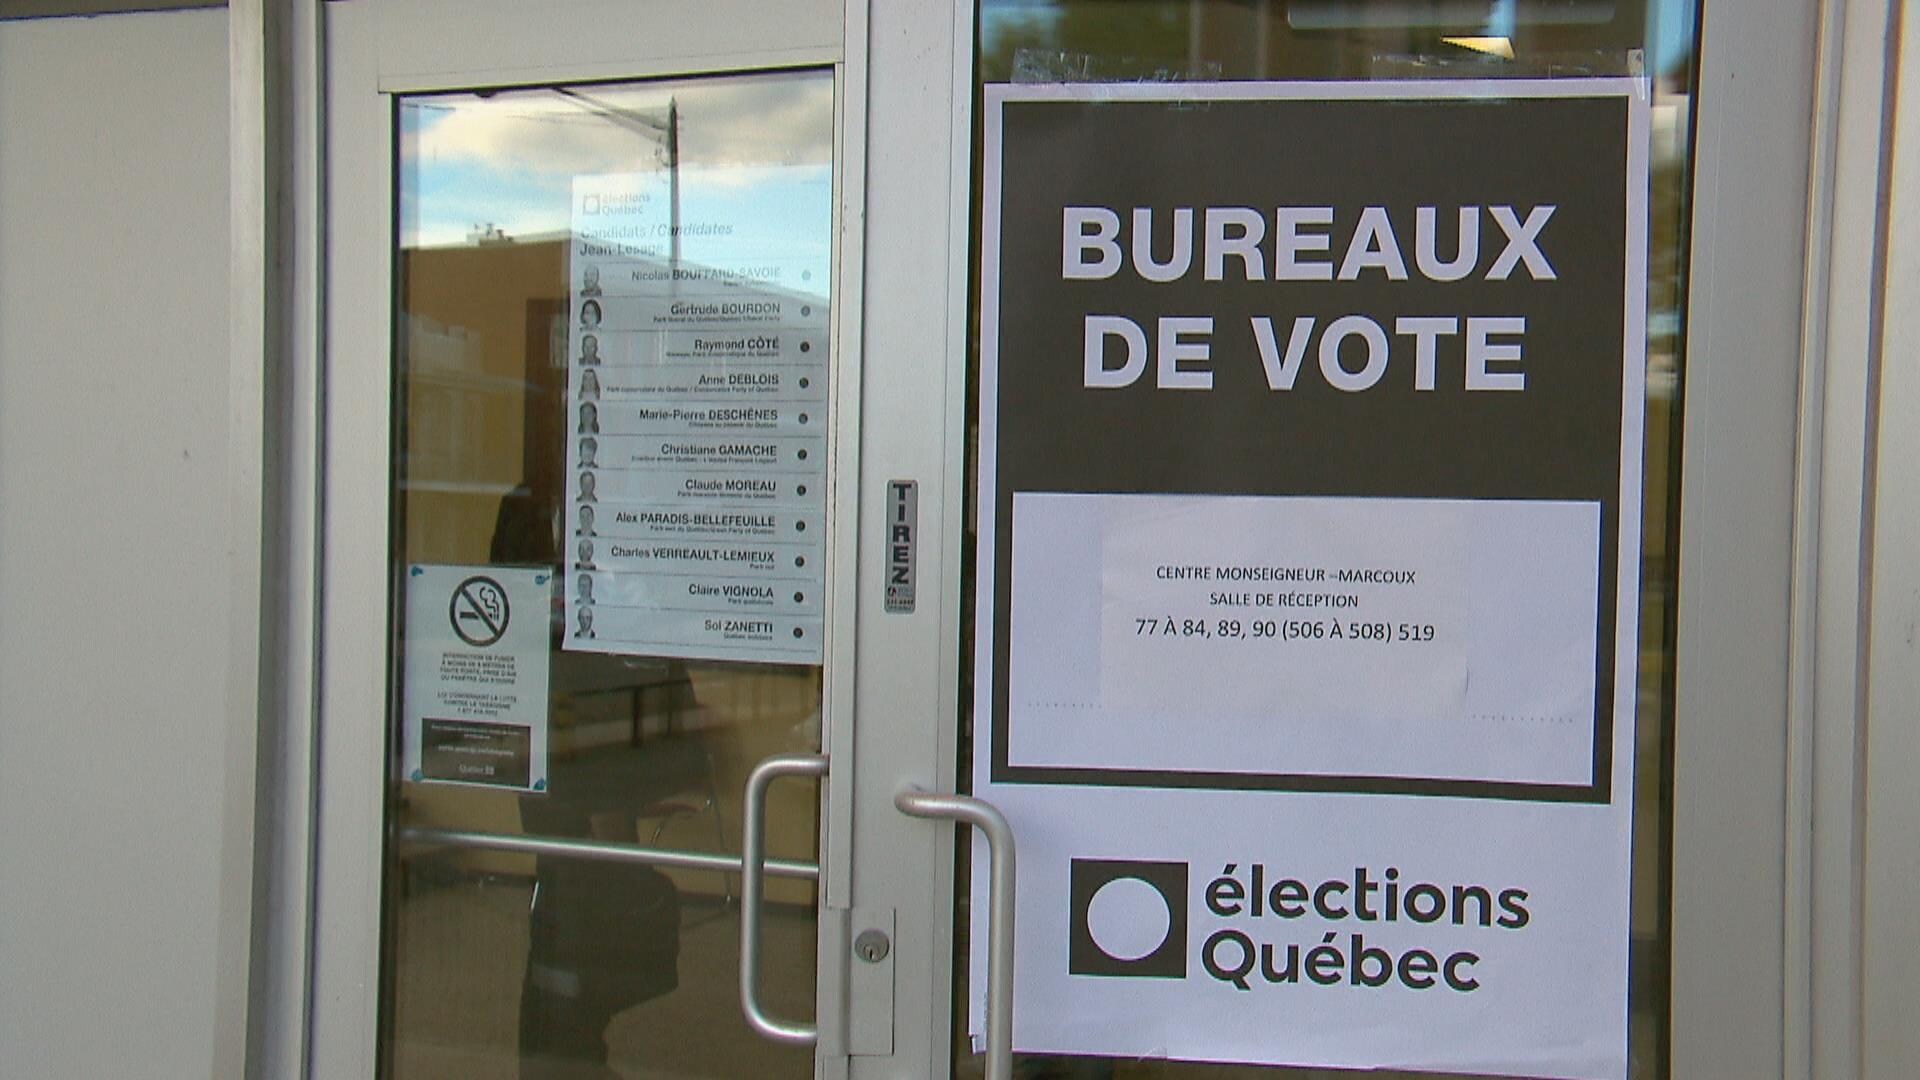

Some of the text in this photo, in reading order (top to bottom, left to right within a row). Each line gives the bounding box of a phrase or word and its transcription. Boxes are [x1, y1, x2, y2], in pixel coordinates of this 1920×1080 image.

[580, 225, 646, 239] Candidats
[657, 222, 733, 237] Candidates
[1062, 205, 1557, 282] BUREAUX
[632, 269, 669, 281] Nicolas
[671, 303, 780, 315] Gertrude BOURDON
[695, 336, 779, 352] Raymond CÔTÉ
[1083, 315, 1525, 392] DE VOTE
[698, 373, 779, 385] Anne DEBLOIS
[639, 407, 778, 421] Marie-Pierre DESCHÊNES
[661, 443, 777, 456] Christiane GAMACHE
[685, 479, 776, 491] Claude MOREAU
[616, 511, 775, 527] Alex PARADIS-BELLEFEUILLE
[892, 483, 912, 584] TIREZ
[611, 546, 774, 563] Charles VERREAULT-LEMIEUX
[1156, 566, 1211, 583] CENTRE
[1216, 566, 1325, 583] MONSEIGNEUR
[689, 583, 773, 598] Claire VIGNOLA
[1209, 591, 1358, 608] SALLE DE RÉCEPTION
[705, 619, 772, 633] Sol ZANETTI
[1135, 615, 1435, 642] 77 À 84, 89, 90 (506 À 508) 519
[1205, 863, 1530, 929] élections
[1201, 929, 1481, 991] Québec
